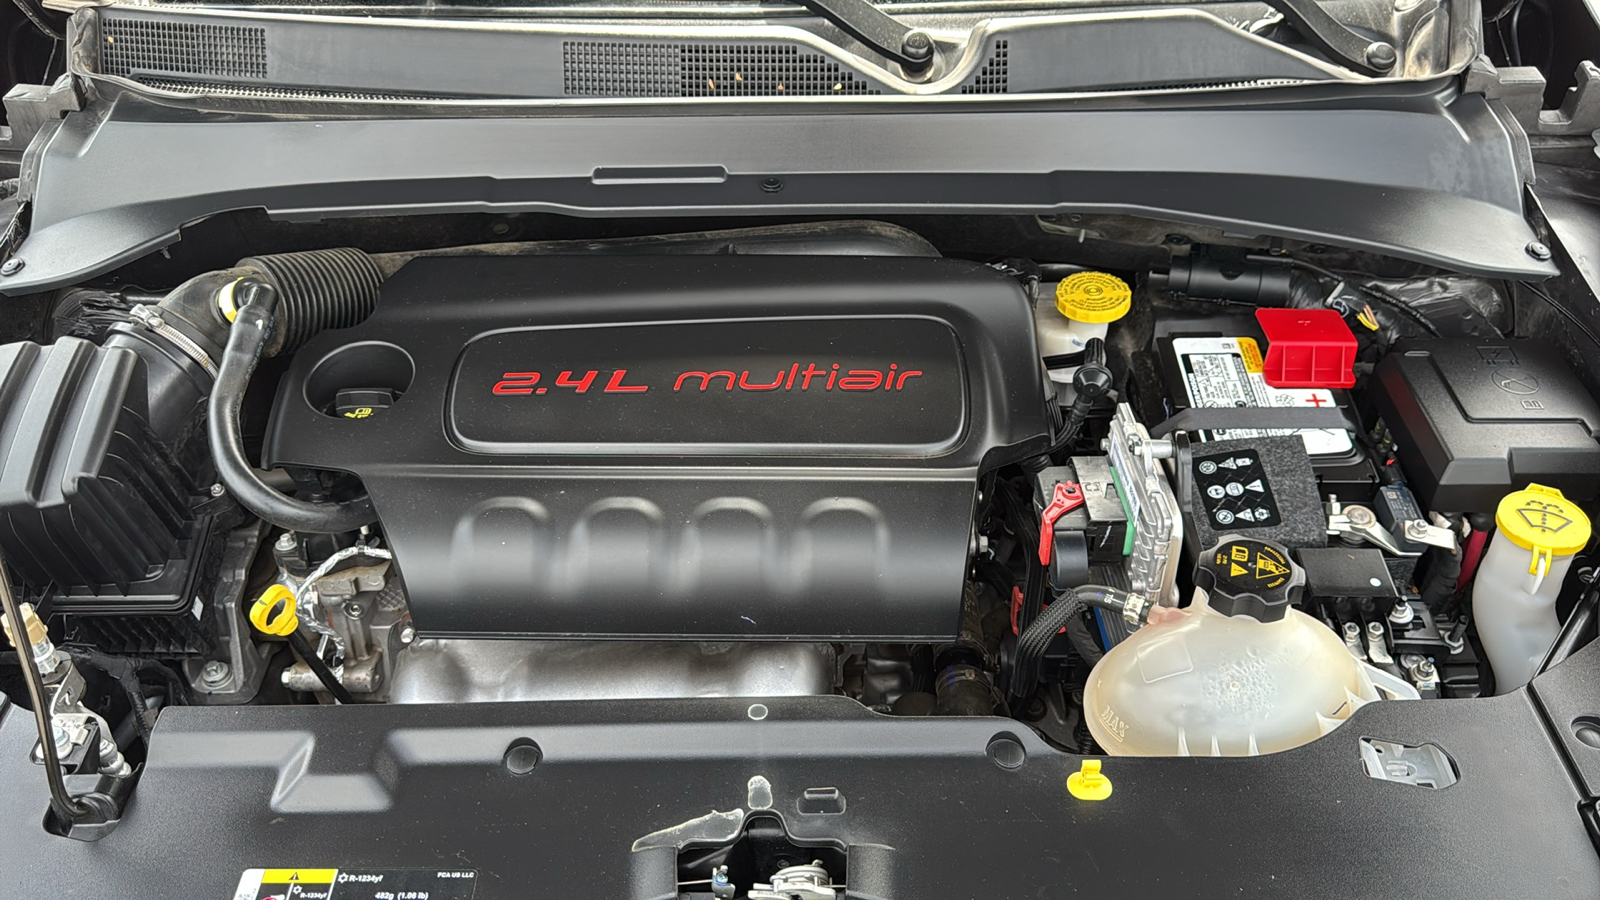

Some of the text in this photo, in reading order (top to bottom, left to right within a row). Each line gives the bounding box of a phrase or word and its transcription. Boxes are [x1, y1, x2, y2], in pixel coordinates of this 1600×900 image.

[492, 363, 922, 394] 2.4L multiair
[1099, 704, 1130, 738] MAX
[349, 874, 383, 883] R-1234yf
[375, 892, 394, 900] 482g
[418, 892, 429, 900] lb)
